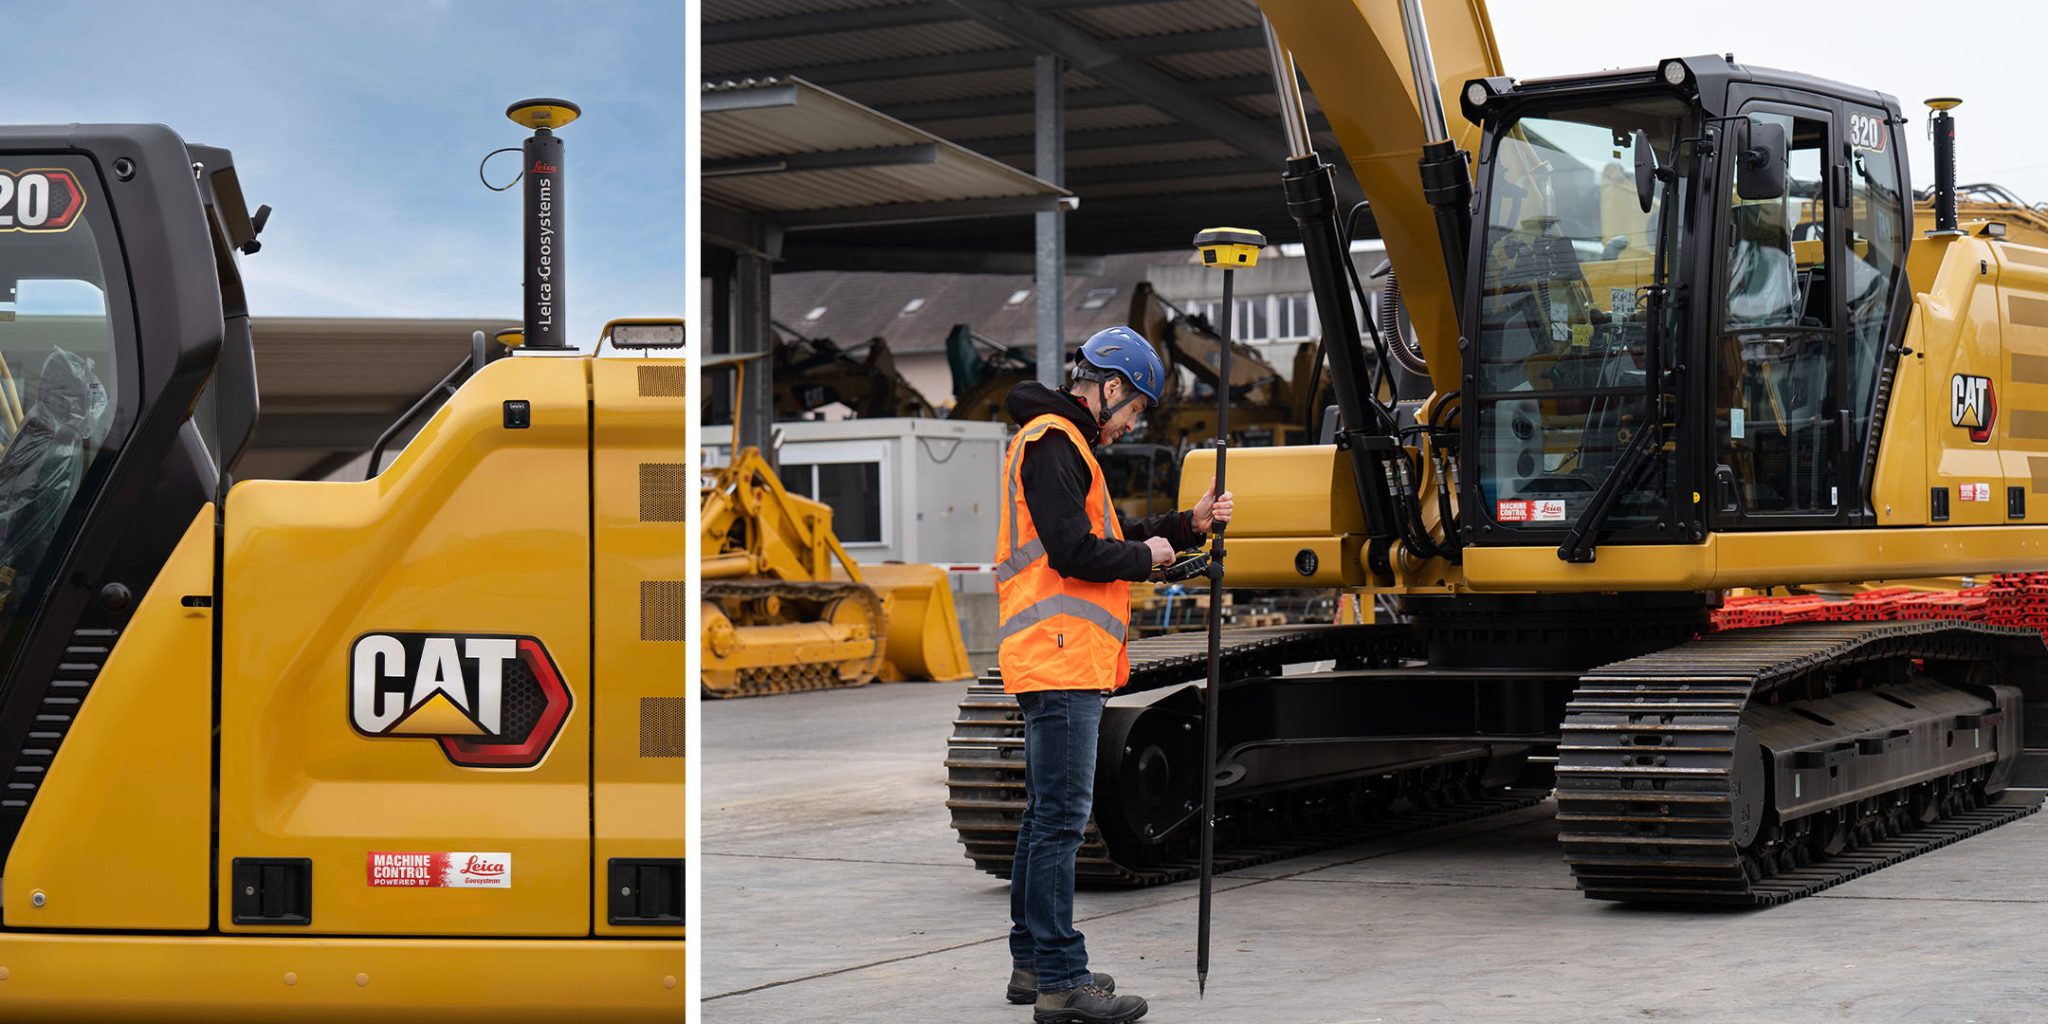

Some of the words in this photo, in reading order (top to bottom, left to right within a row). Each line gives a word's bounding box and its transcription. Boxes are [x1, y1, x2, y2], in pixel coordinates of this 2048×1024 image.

[1851, 114, 1878, 148] 320
[529, 160, 557, 173] Leica
[537, 178, 554, 277] Geosystems
[538, 283, 551, 325] Leica
[1952, 375, 1987, 427] CAT
[1541, 502, 1562, 514] Leica
[354, 634, 517, 736] CAT
[374, 855, 431, 866] MACHINE
[460, 855, 505, 876] Leica
[374, 866, 431, 879] CONTROL
[464, 877, 501, 885] Geosystems
